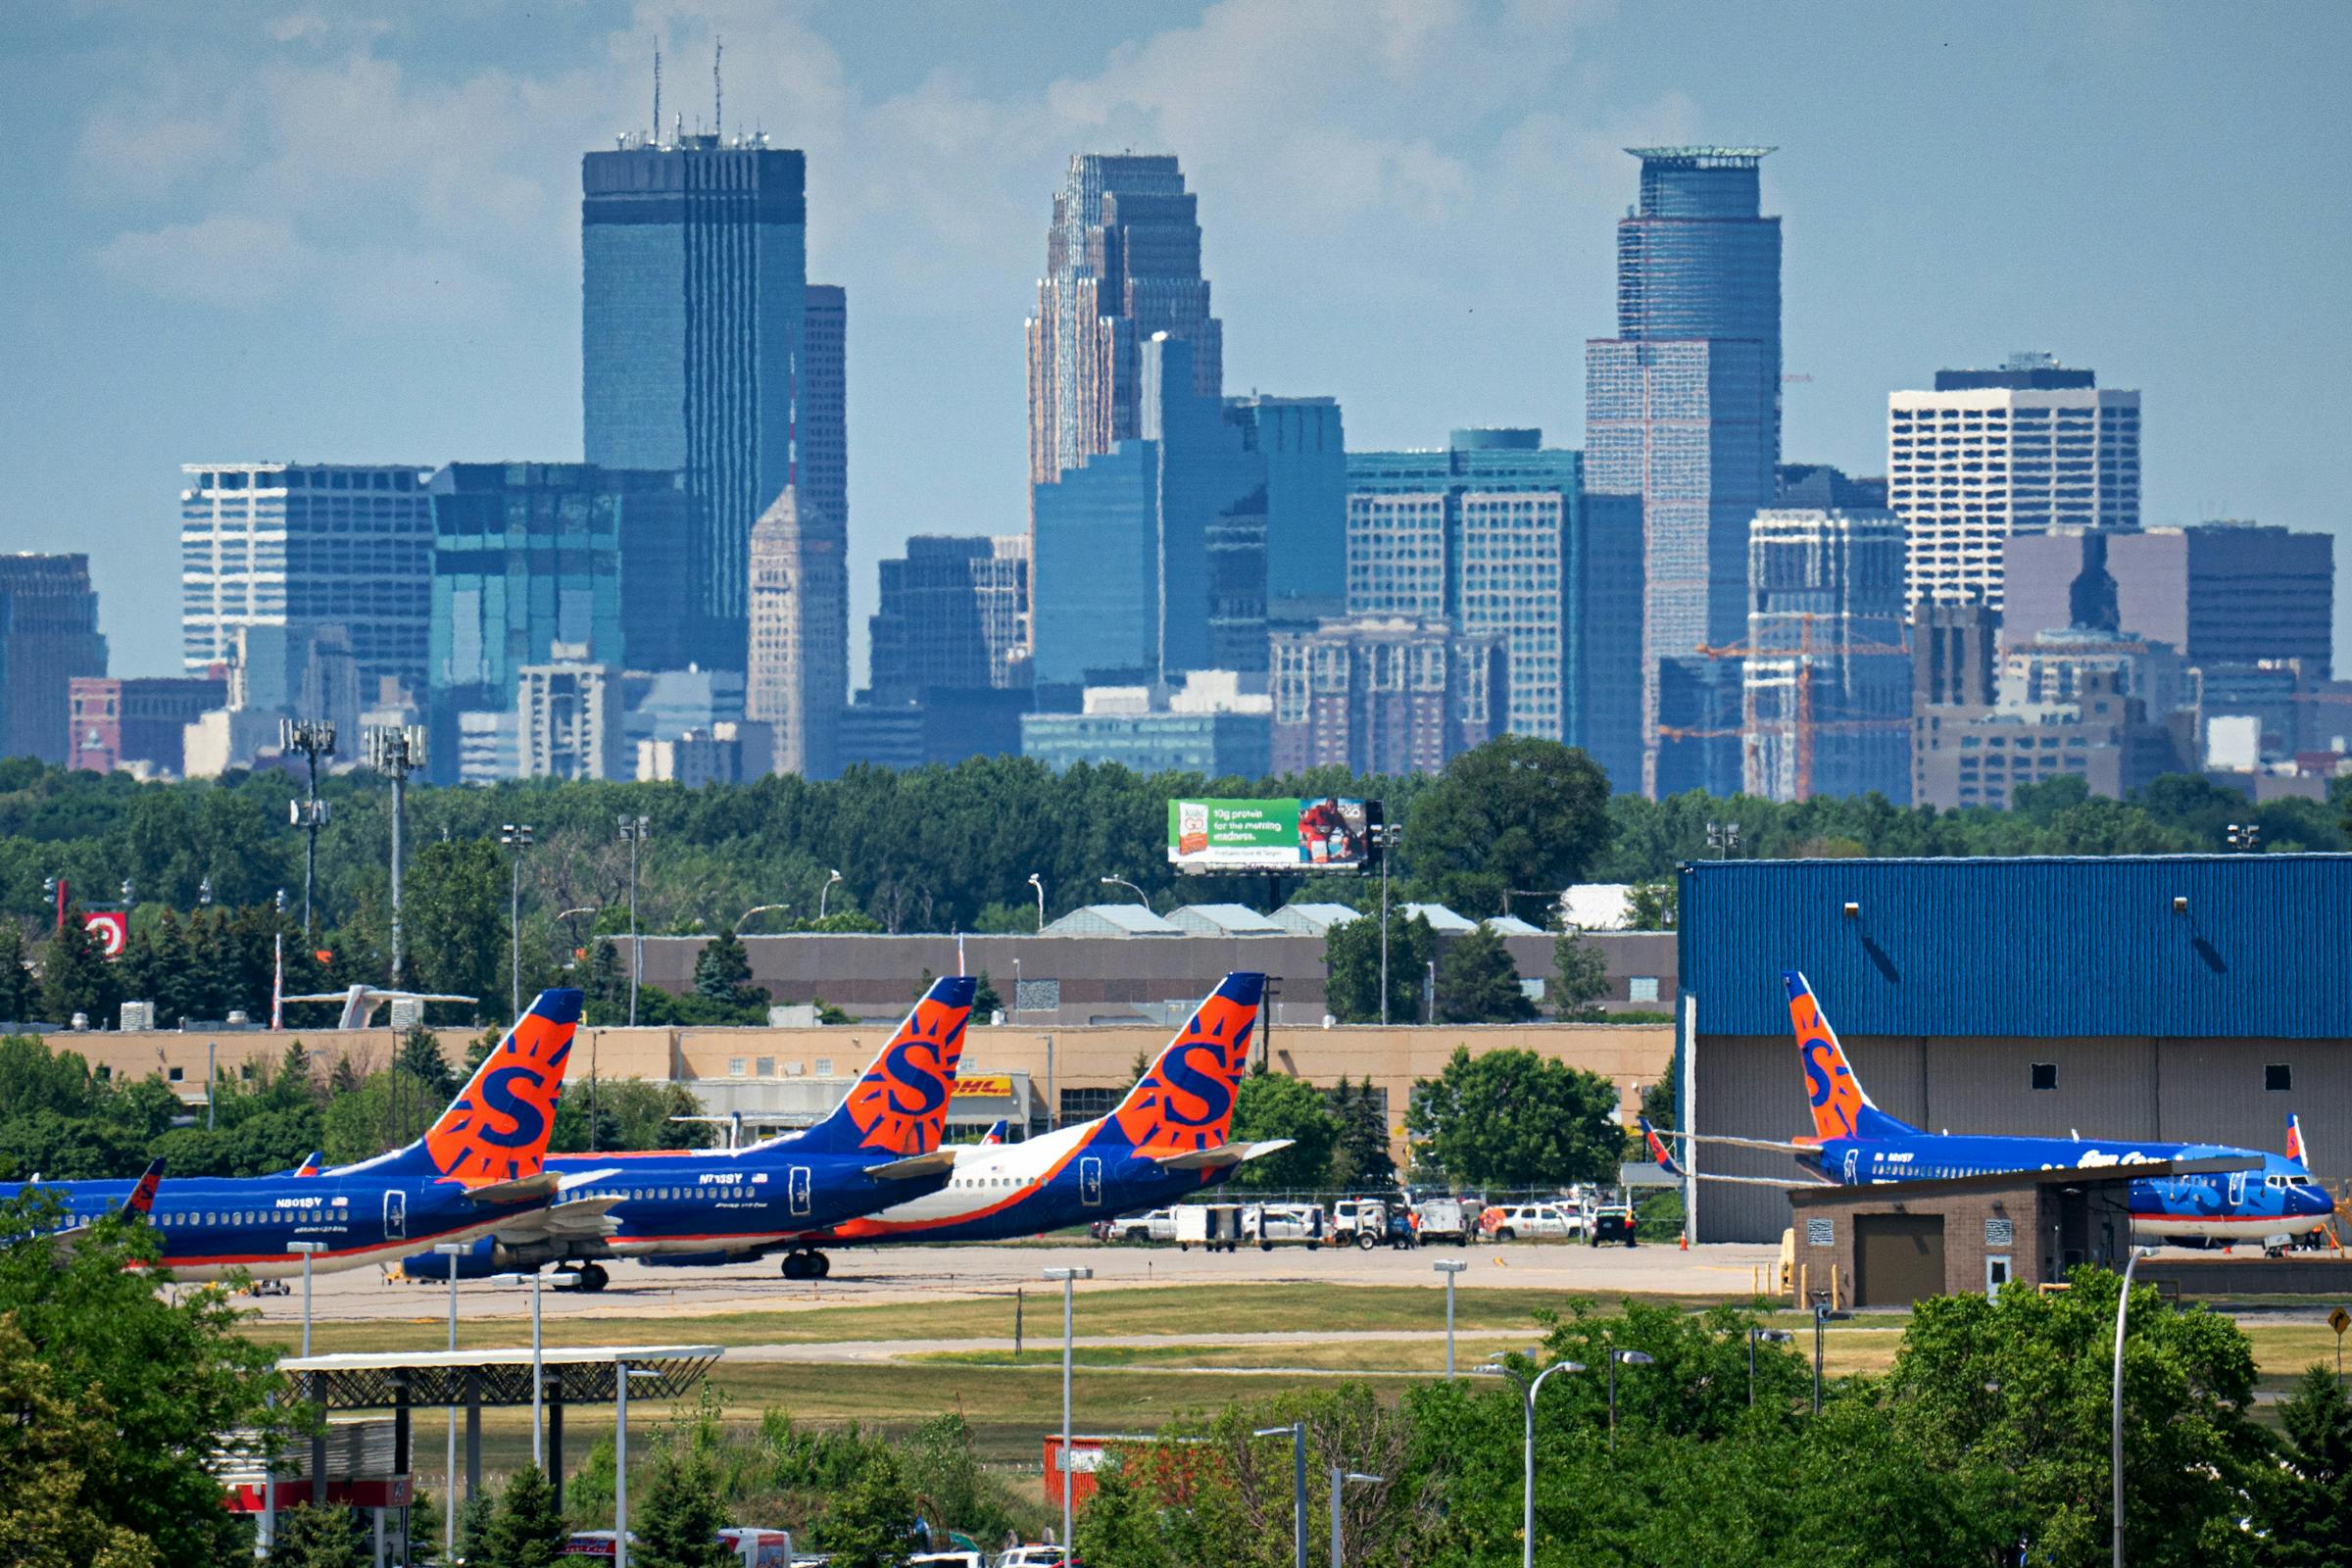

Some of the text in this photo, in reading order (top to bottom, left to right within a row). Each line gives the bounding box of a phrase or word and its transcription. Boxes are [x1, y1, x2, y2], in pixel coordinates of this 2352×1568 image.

[477, 1066, 545, 1148] S
[885, 1041, 946, 1116] S
[1161, 1042, 1231, 1126] S
[1805, 1038, 1834, 1107] S
